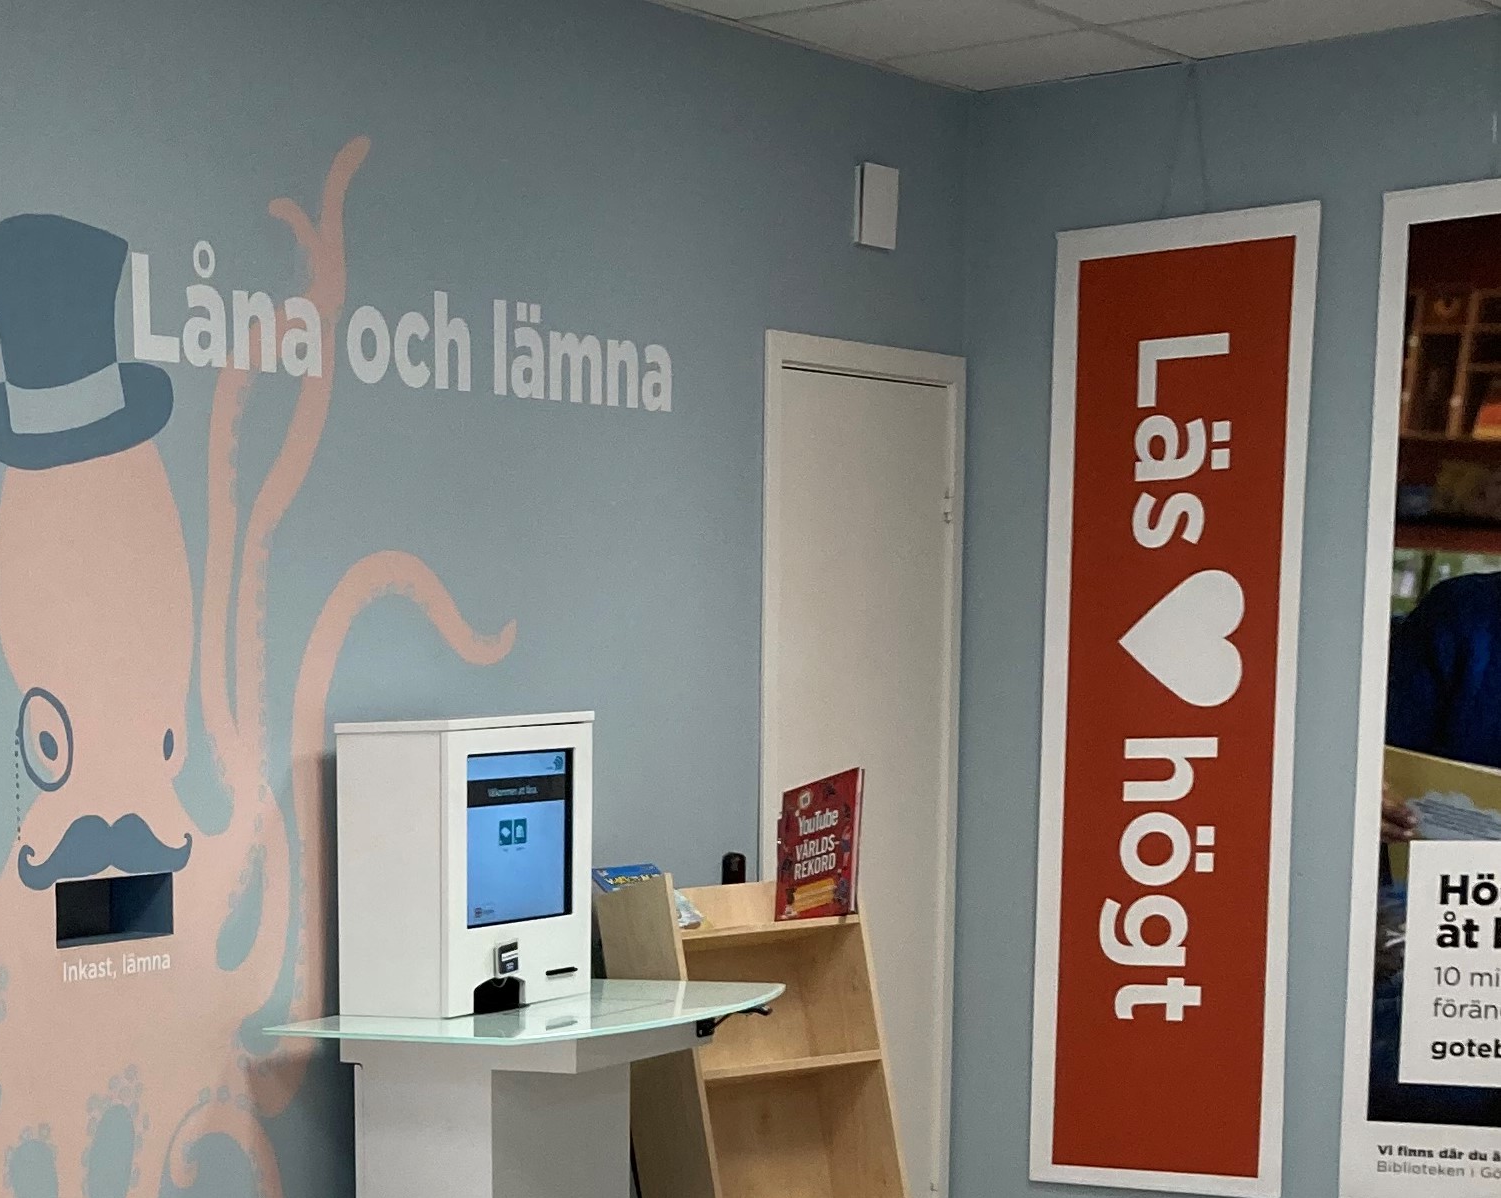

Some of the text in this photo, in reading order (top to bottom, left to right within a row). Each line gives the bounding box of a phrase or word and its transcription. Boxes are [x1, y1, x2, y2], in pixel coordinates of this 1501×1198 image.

[130, 240, 673, 412] Låna och lämna
[1098, 332, 1232, 1022] Läs högt
[798, 808, 839, 836] YouTube
[795, 834, 840, 862] VÄRLDS-
[794, 852, 836, 880] REKORD
[1439, 873, 1501, 906] Hö
[1436, 910, 1480, 950] åt
[62, 952, 172, 983] Inkast, lämna
[1434, 966, 1461, 987] 10
[1433, 996, 1501, 1020] förän
[1378, 1145, 1394, 1157] Vi
[1397, 1145, 1434, 1159] finns
[1439, 1147, 1465, 1161] där
[1468, 1148, 1488, 1162] du
[1376, 1160, 1466, 1178] Biblioteken
